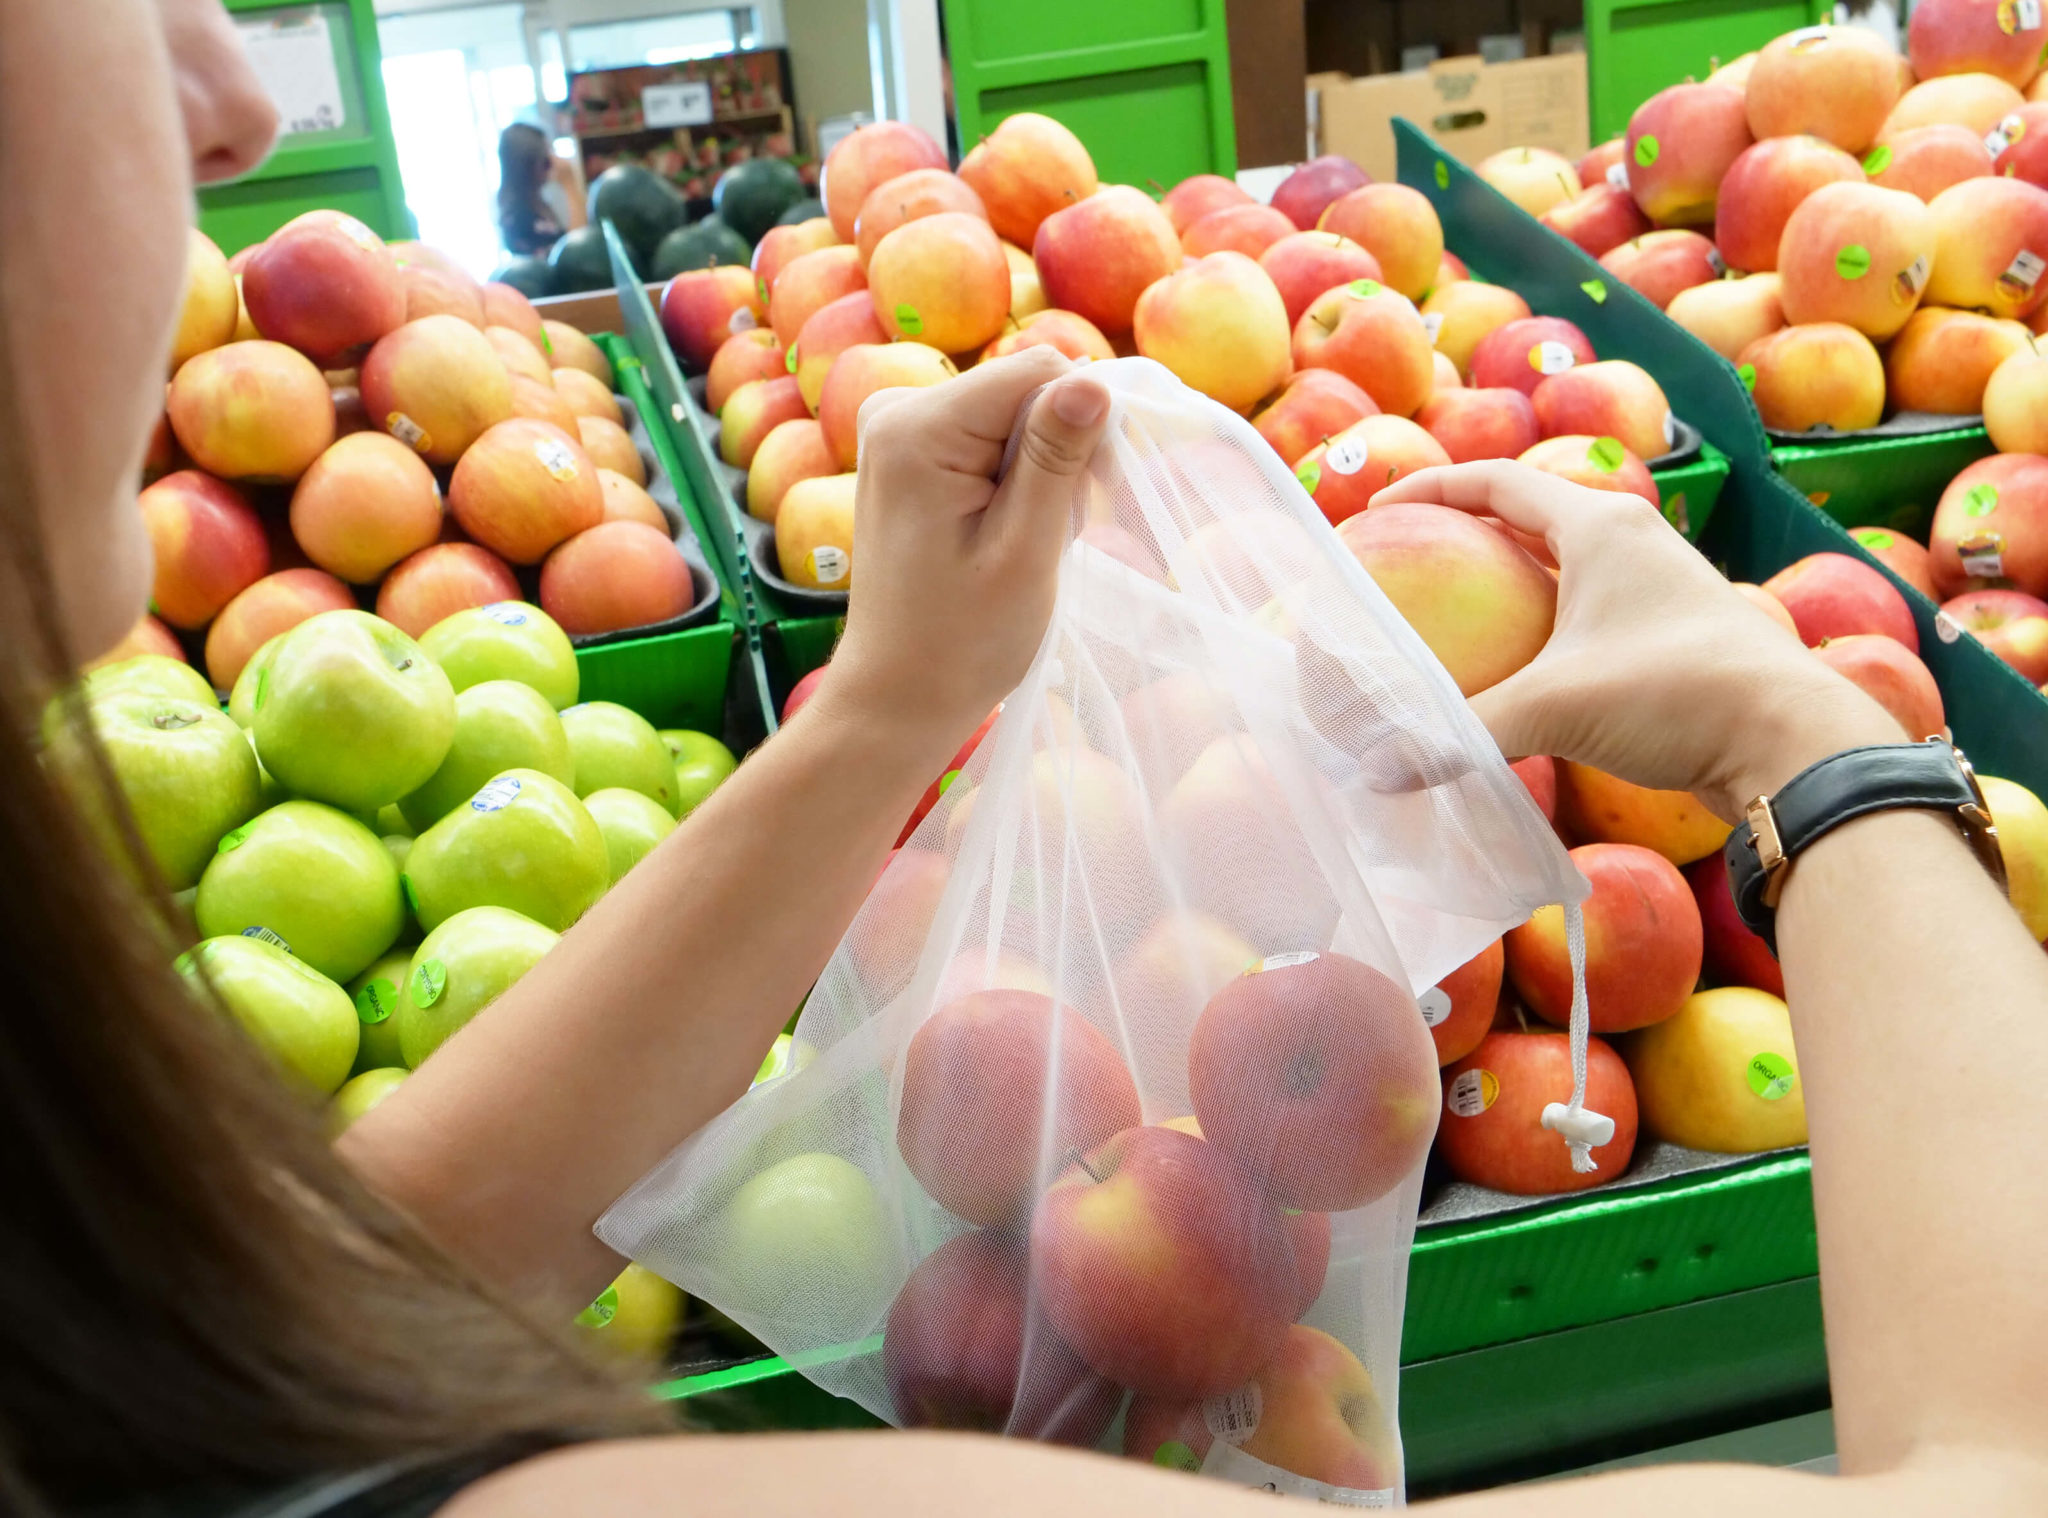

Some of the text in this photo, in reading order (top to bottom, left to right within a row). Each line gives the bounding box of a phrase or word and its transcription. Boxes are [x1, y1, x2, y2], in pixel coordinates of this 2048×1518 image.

[366, 985, 384, 1017] ORGANIC
[1753, 1060, 1789, 1093] ORGANIC
[594, 1300, 612, 1320] ANIC
